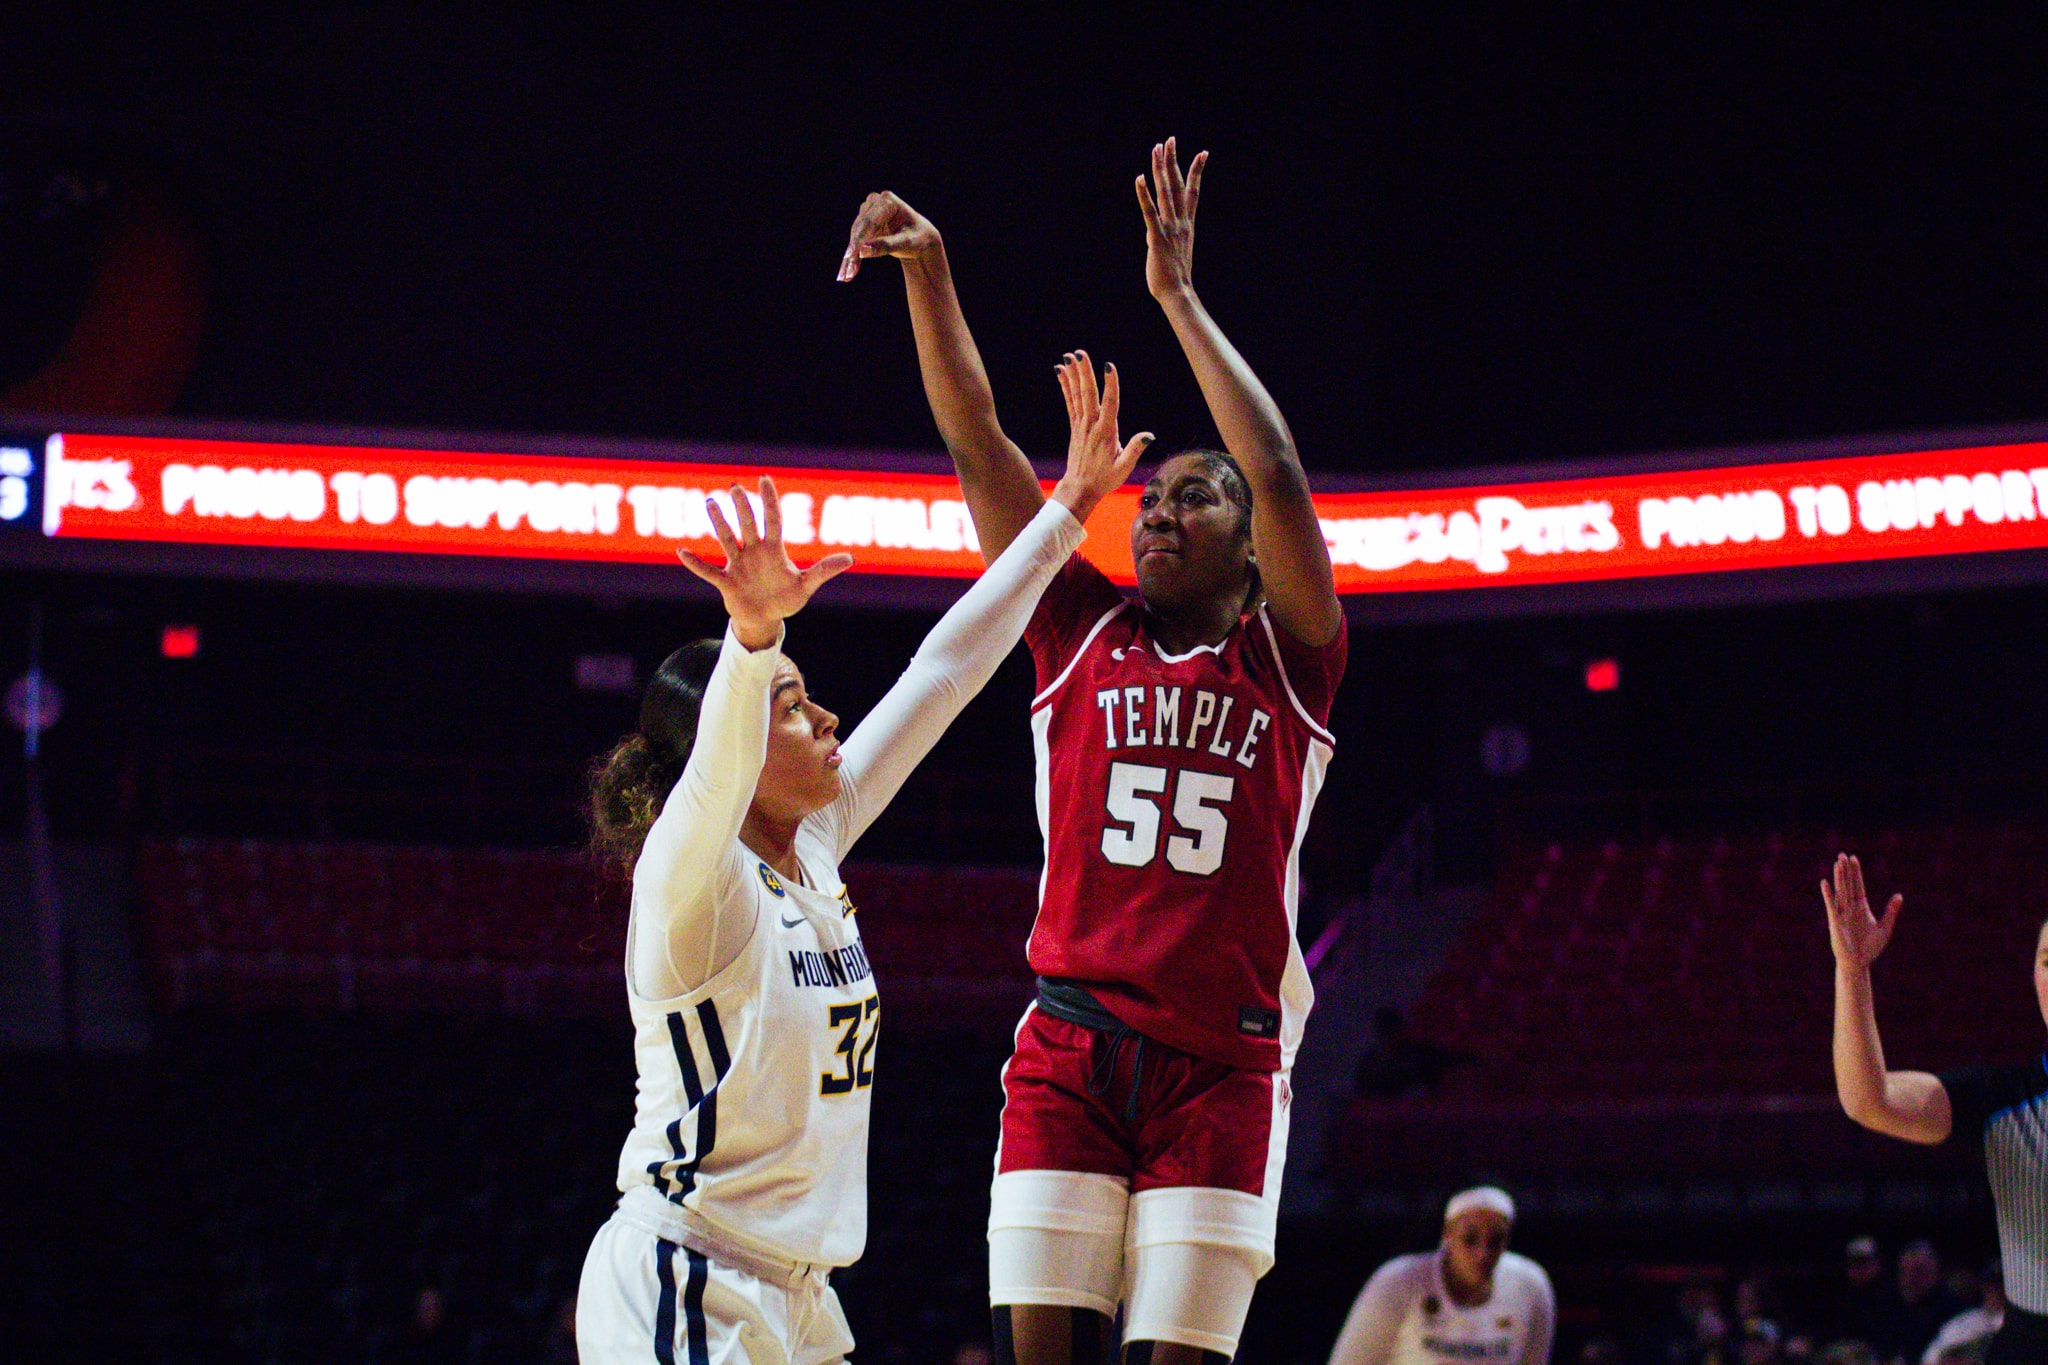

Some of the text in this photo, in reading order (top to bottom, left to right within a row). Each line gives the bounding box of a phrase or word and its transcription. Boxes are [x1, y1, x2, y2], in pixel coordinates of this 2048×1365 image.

[162, 464, 325, 521] PROUD
[330, 472, 398, 524] TO
[404, 476, 624, 534] SUPPORT
[1639, 490, 1785, 548] PROUD
[1790, 485, 1851, 537] TO
[1097, 686, 1271, 769] TEMPLE
[1101, 761, 1234, 876] 55
[819, 993, 880, 1097] 32
